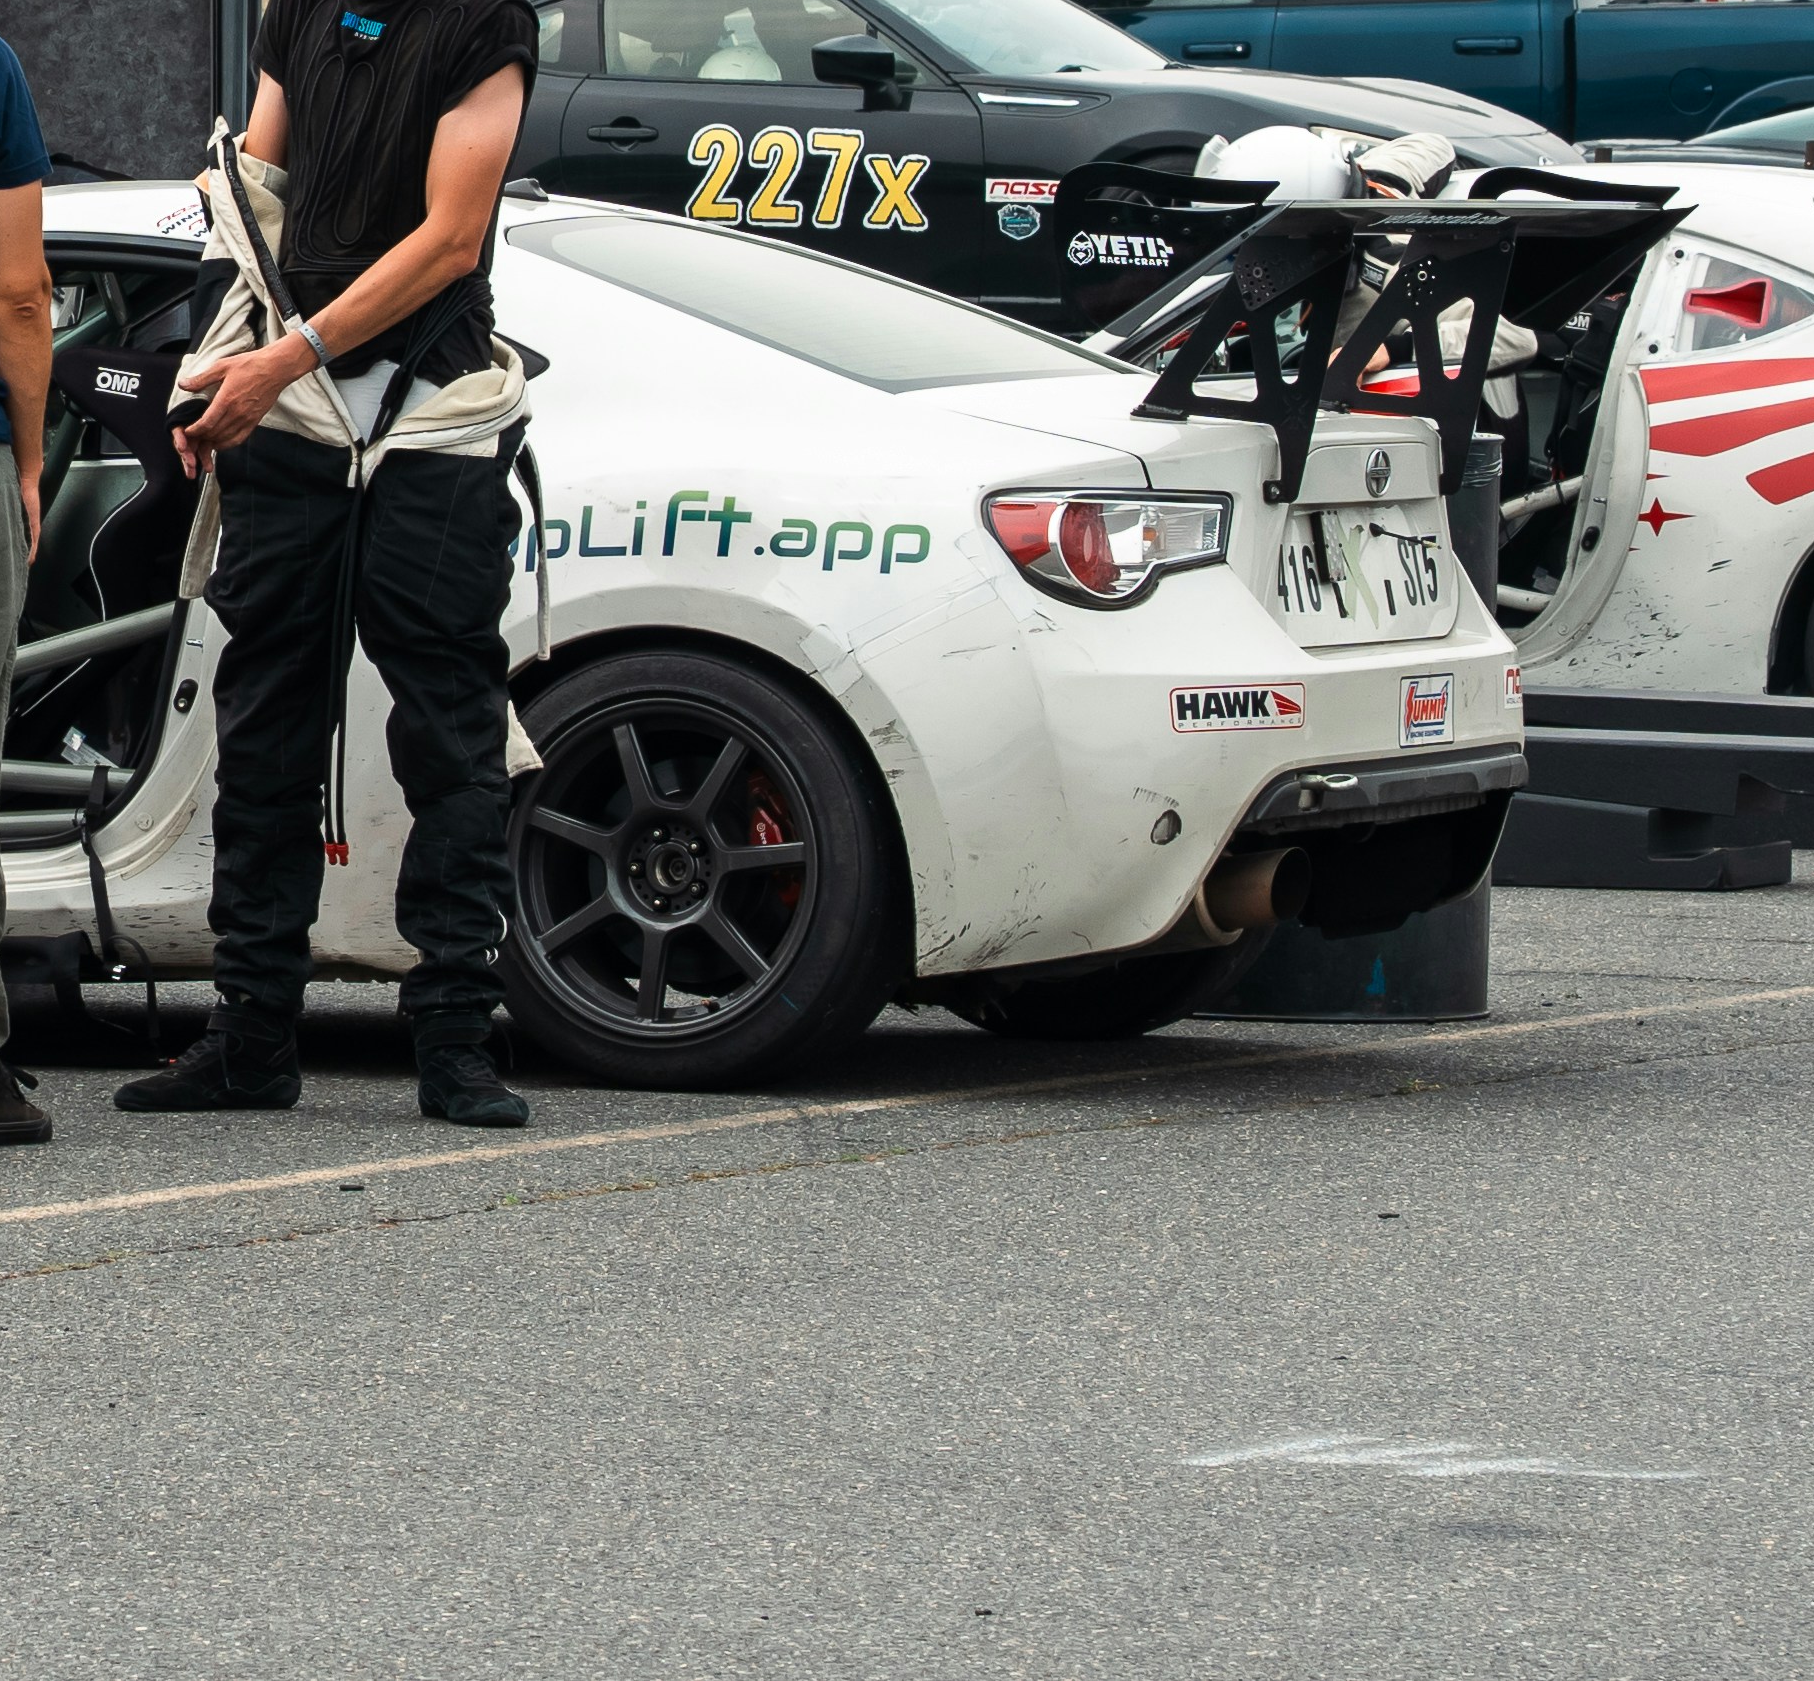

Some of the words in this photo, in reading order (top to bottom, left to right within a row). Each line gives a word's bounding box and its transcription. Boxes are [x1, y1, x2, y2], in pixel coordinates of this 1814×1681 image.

[686, 123, 930, 231] 227x
[1090, 234, 1159, 258] YETI
[96, 371, 140, 394] OMP
[509, 489, 932, 574] pLift.app
[1278, 543, 1322, 613] 416
[1175, 690, 1271, 721] HAWK
[1178, 718, 1302, 729] PERFORMANCE
